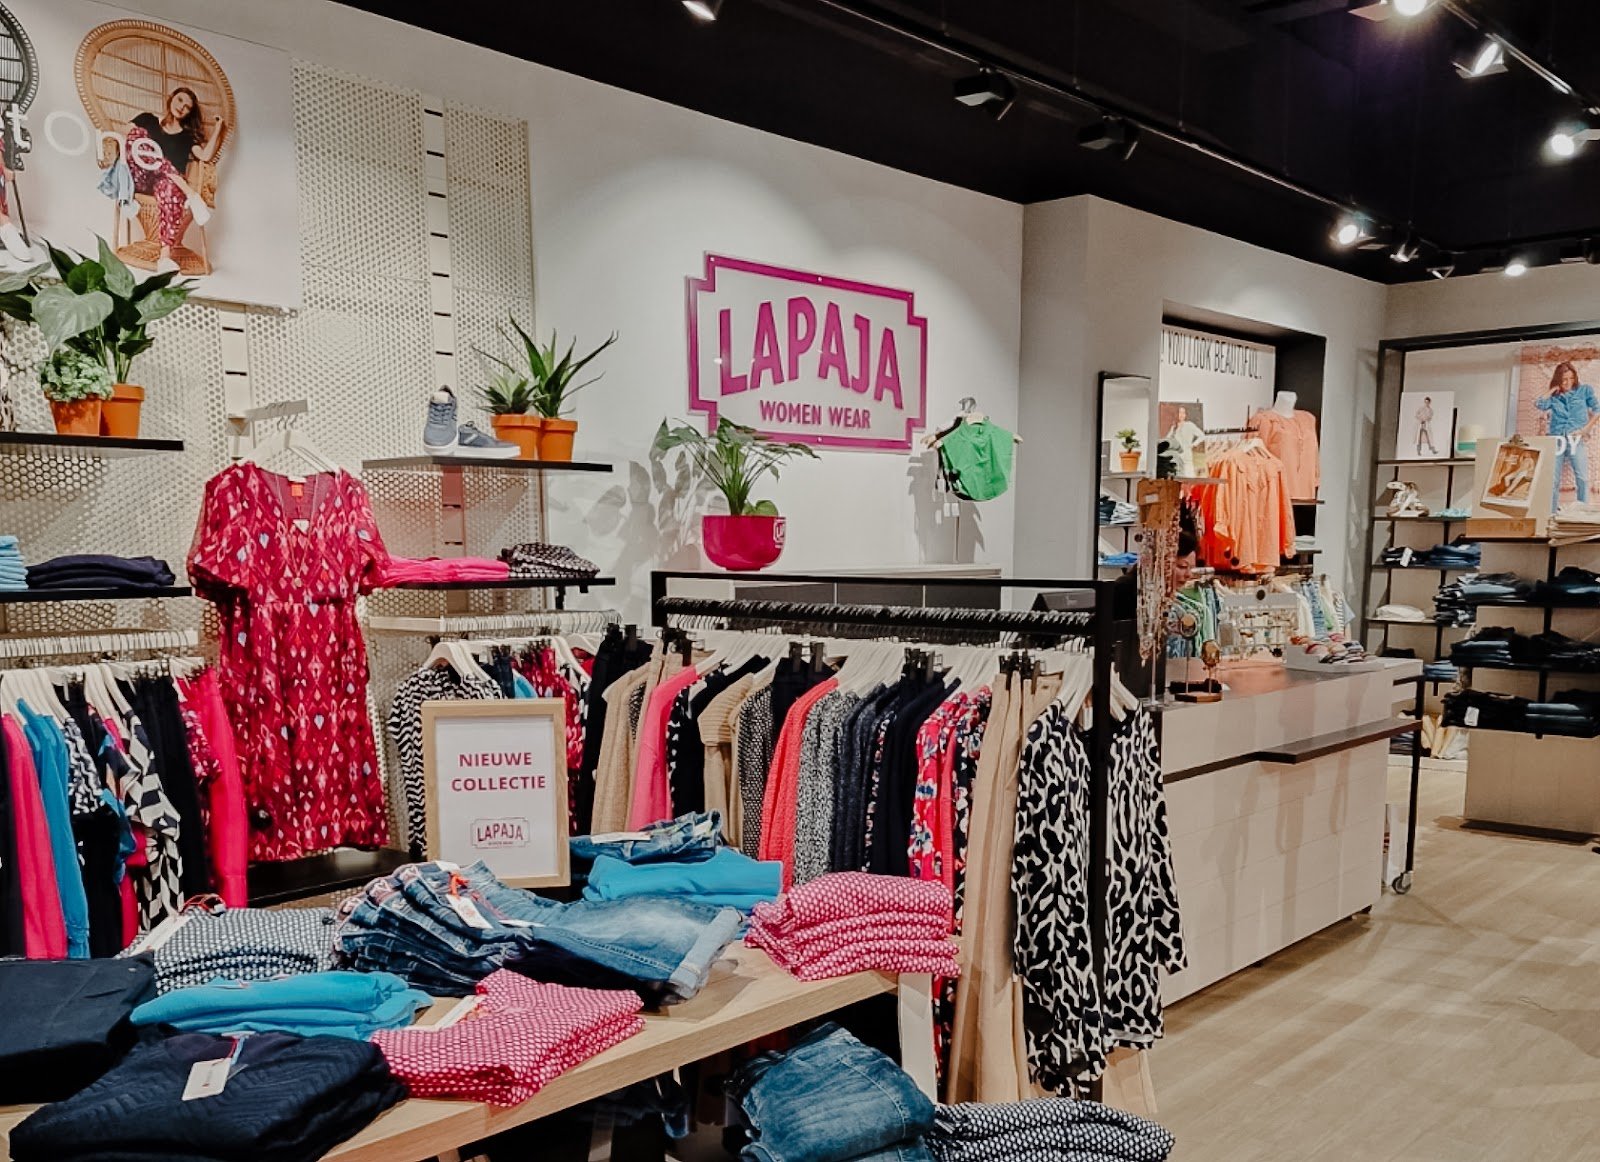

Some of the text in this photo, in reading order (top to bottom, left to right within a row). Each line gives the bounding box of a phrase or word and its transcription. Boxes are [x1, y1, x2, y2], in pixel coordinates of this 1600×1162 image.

[44, 111, 164, 171] one
[719, 296, 903, 410] LAPAJA
[1167, 329, 1186, 365] YOU
[1188, 333, 1212, 371] LOOK
[760, 400, 871, 428] WOMEN WEAR
[1555, 435, 1582, 456] DY
[459, 752, 532, 767] NIEUWE
[451, 775, 546, 792] COLLECTIE
[477, 823, 523, 842] LAPAJA
